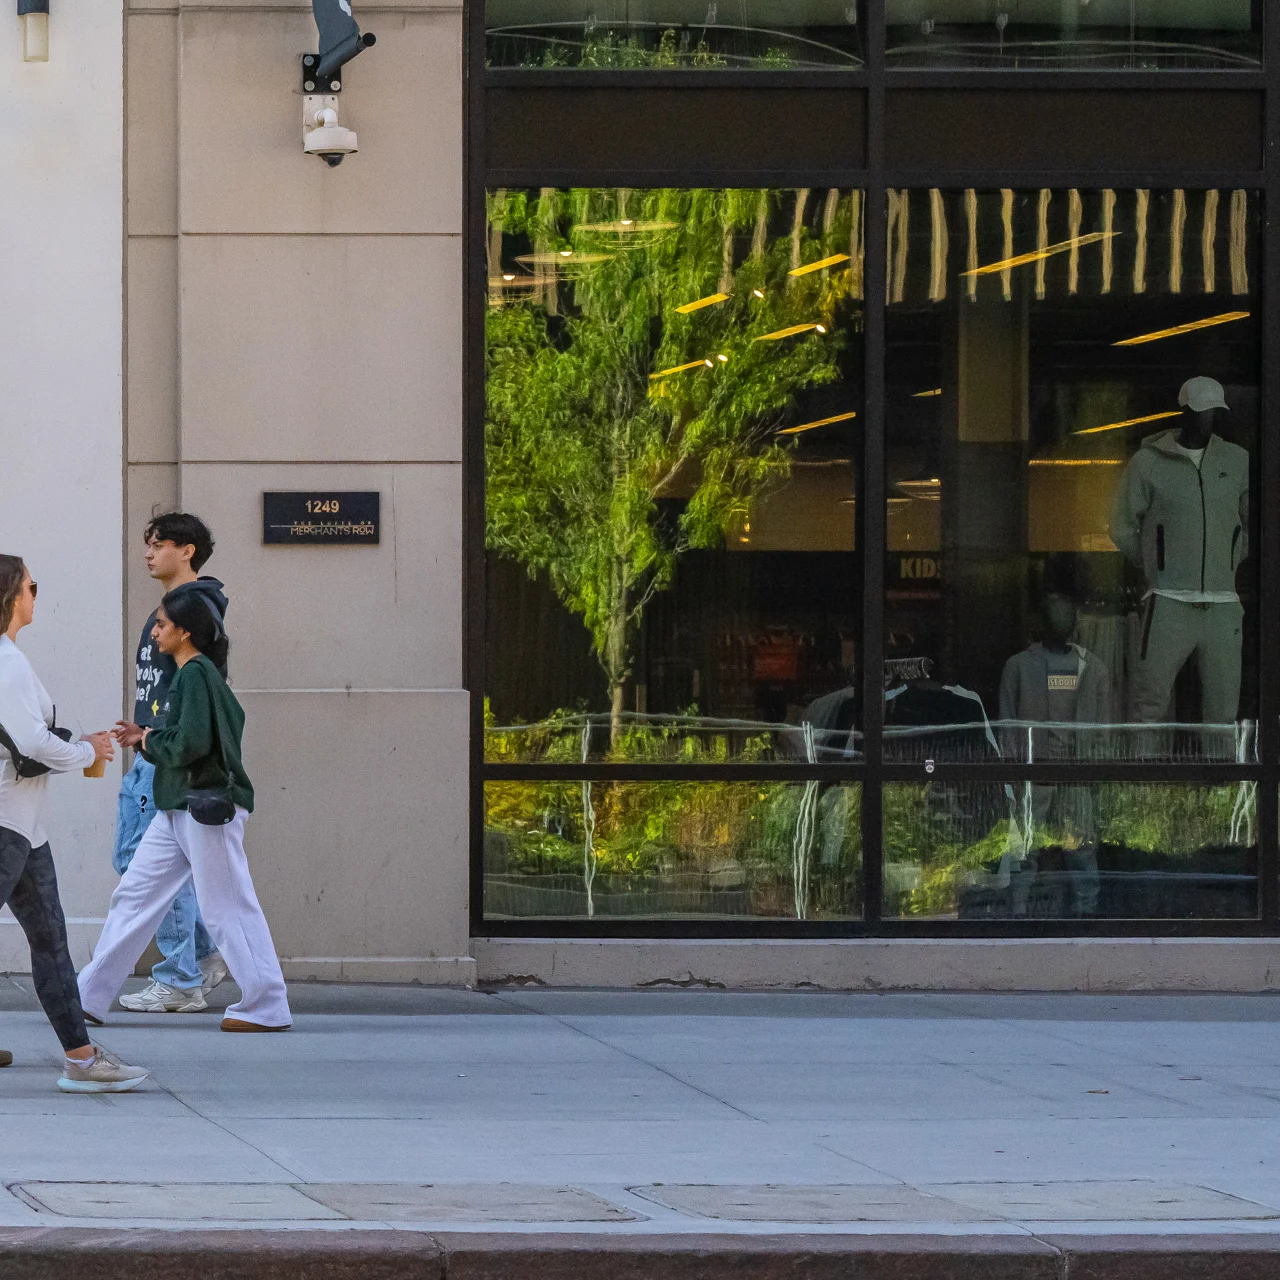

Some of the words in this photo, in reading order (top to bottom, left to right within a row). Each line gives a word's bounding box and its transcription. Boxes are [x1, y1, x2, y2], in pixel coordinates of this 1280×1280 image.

[305, 500, 340, 513] 1249
[290, 526, 351, 536] MERCHANTS
[352, 526, 375, 535] ROW
[900, 557, 941, 579] KID
